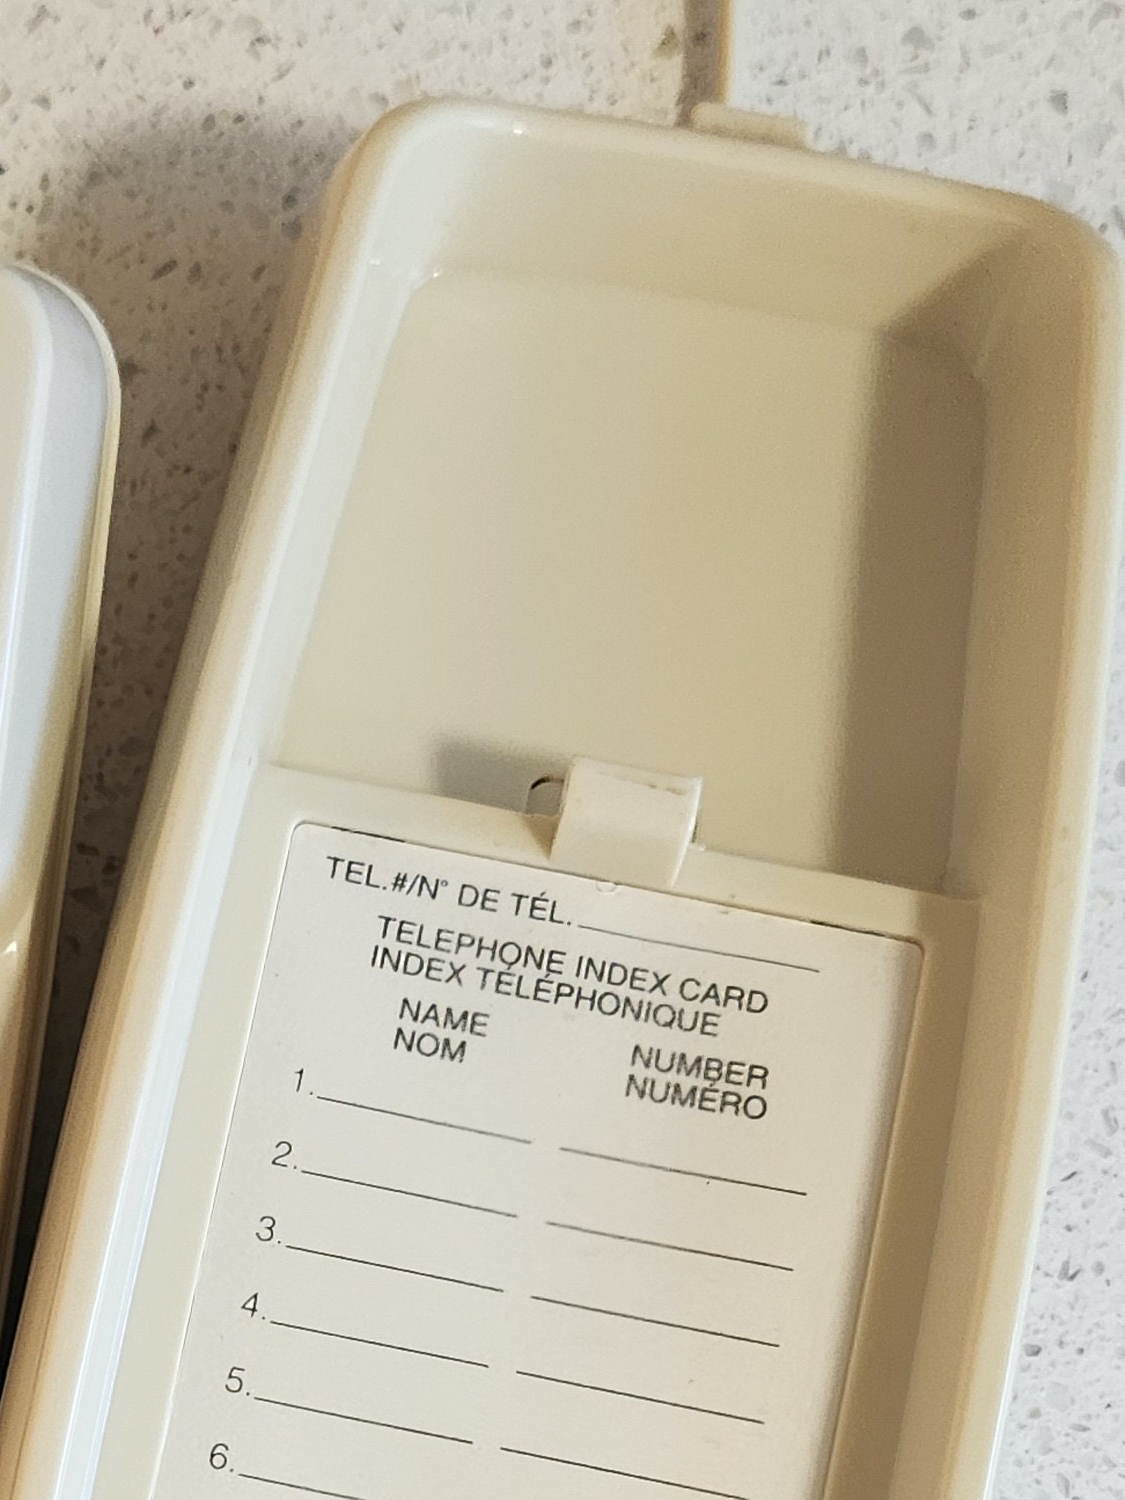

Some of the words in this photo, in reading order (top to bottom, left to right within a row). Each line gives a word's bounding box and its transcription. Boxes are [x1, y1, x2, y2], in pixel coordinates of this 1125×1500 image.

[458, 884, 500, 912] DE
[512, 892, 573, 925] TÉL.
[378, 916, 567, 975] TELEPHONE
[575, 955, 672, 996] INDEX
[679, 978, 769, 1014] CARD
[371, 946, 464, 986] INDEX
[477, 963, 720, 1037] TÉLÉPHONIQUE
[399, 998, 490, 1037] NAME
[393, 1028, 467, 1063] NOM
[294, 1069, 313, 1095] 1.
[631, 1045, 769, 1089] NUMBER
[626, 1072, 767, 1120] NUMÉRO
[272, 1141, 298, 1170] 2.
[255, 1216, 281, 1245] 3.
[241, 1292, 265, 1320] 4.
[225, 1367, 250, 1396] 5.
[209, 1443, 234, 1473] 6.
